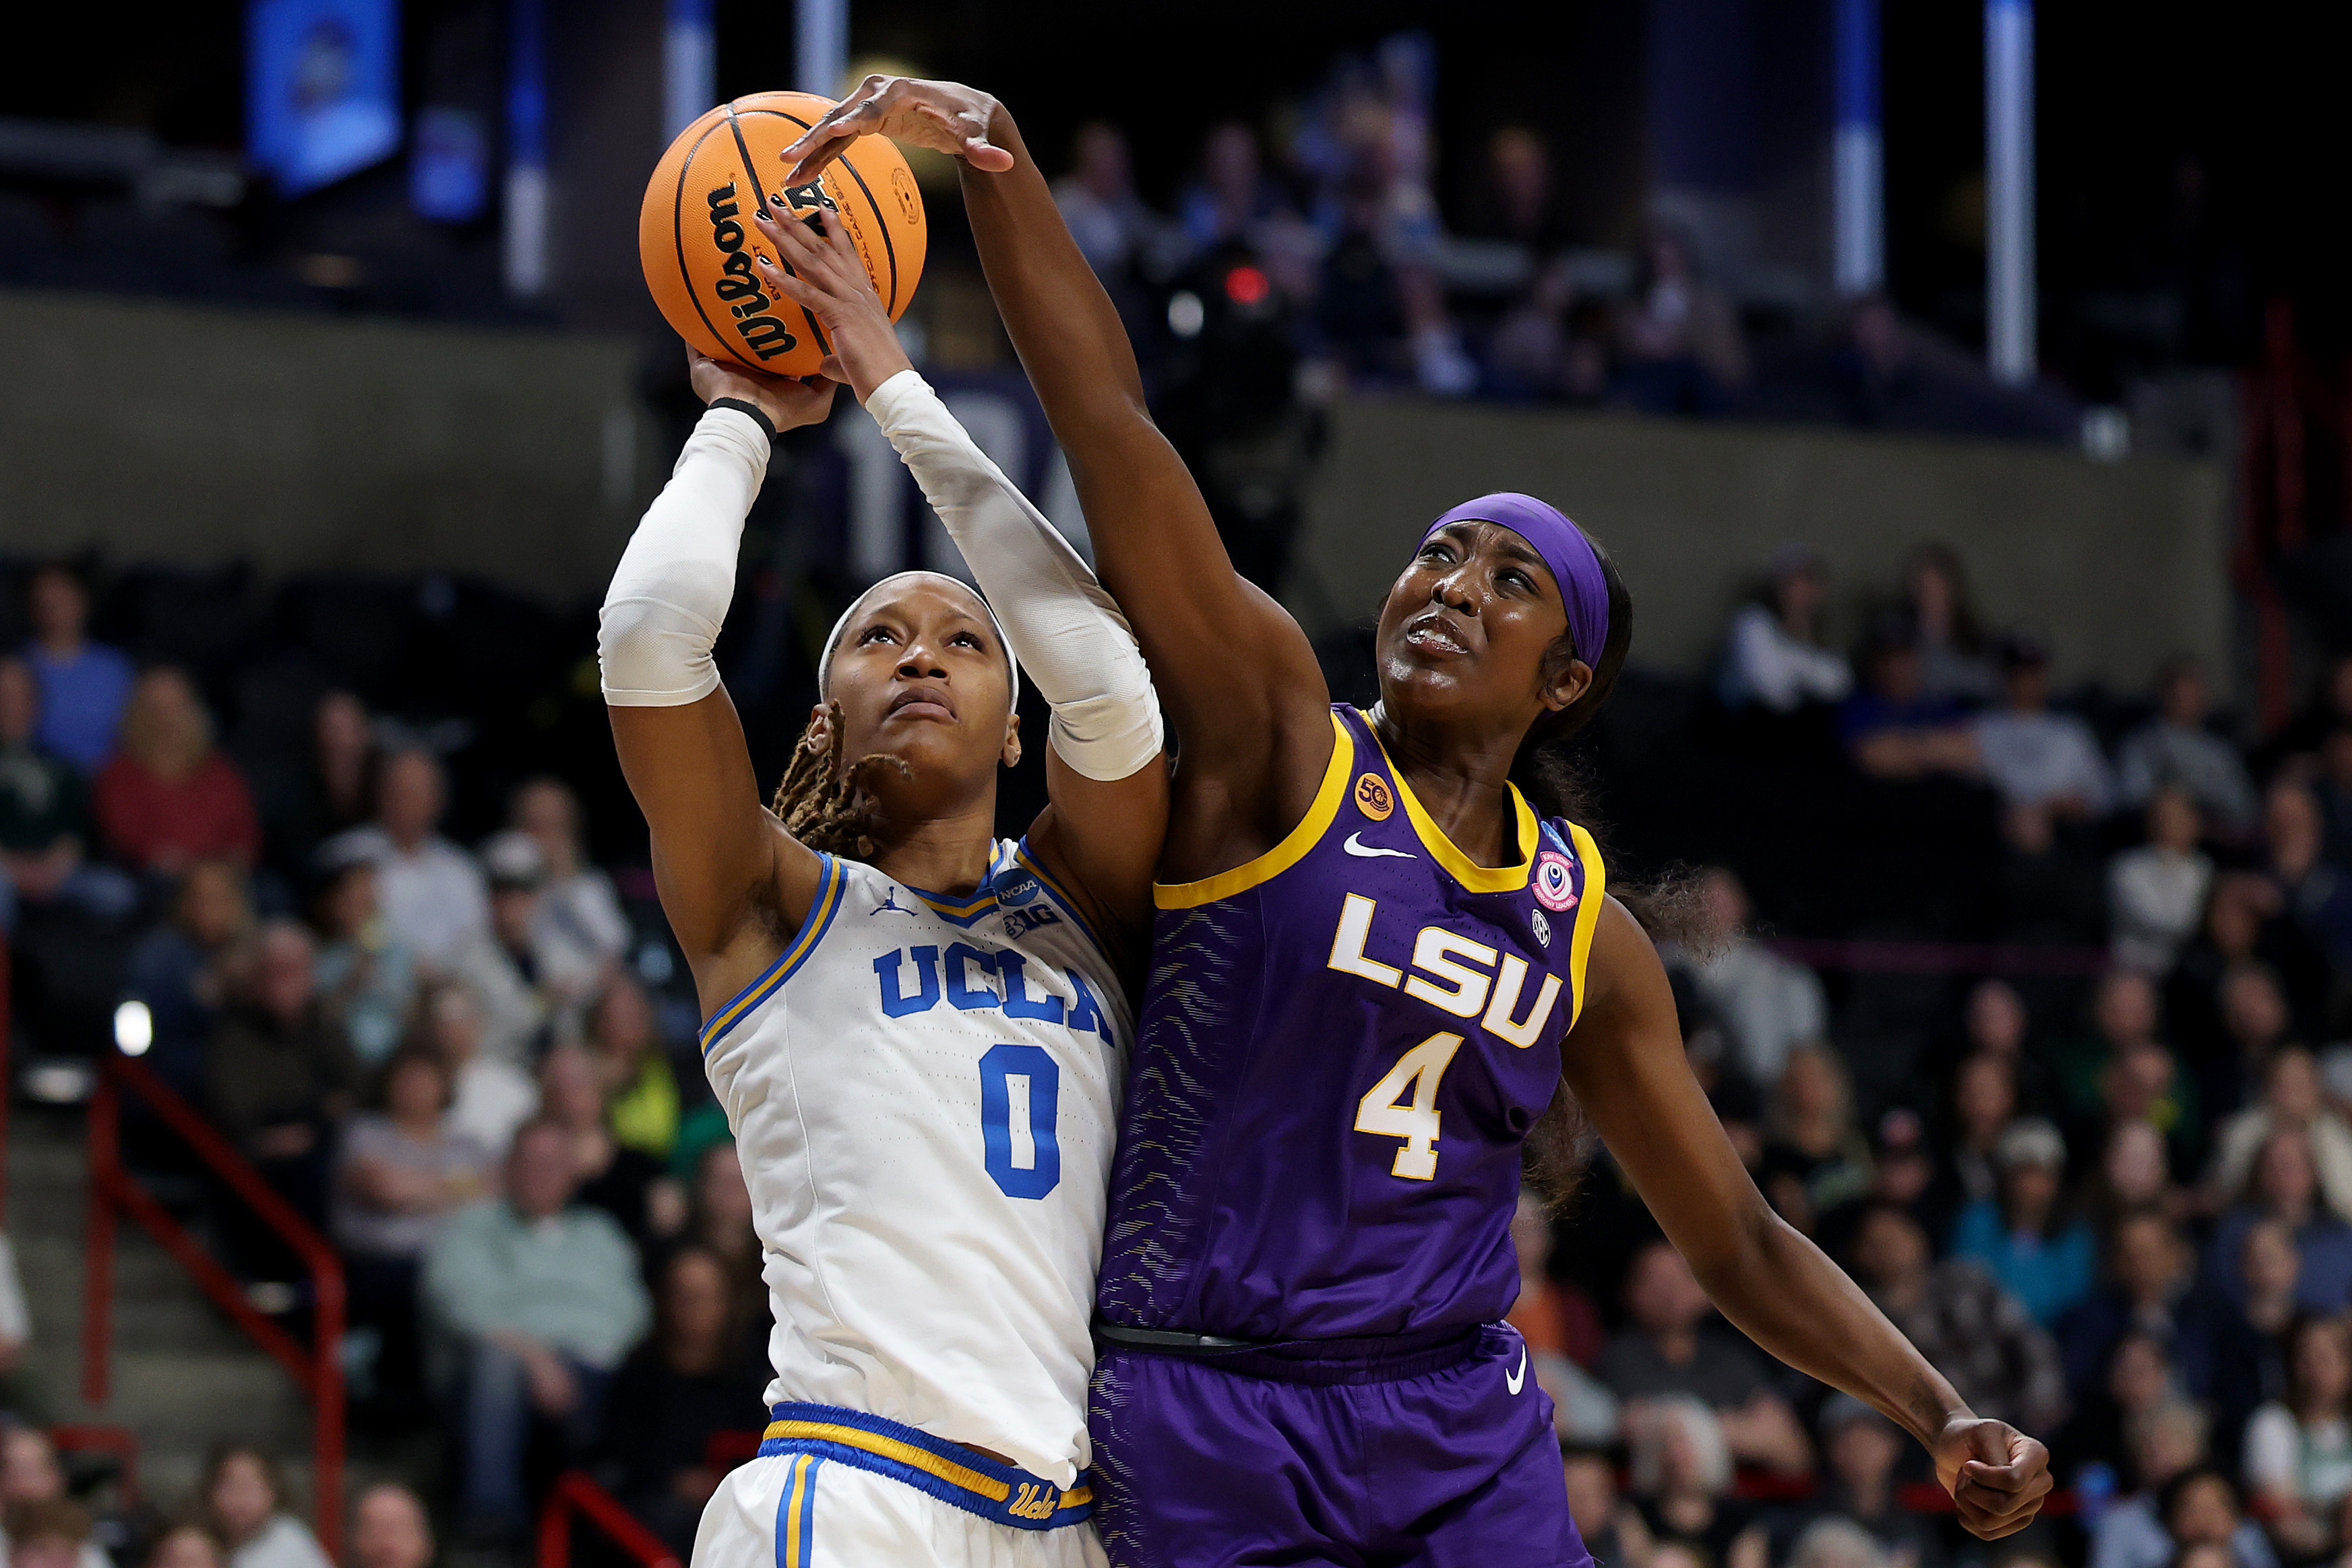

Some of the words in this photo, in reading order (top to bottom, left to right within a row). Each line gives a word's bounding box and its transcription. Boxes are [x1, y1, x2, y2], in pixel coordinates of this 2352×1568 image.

[708, 181, 797, 361] Wilson
[1358, 777, 1388, 805] 50
[999, 880, 1038, 900] NCAA
[1533, 913, 1549, 945] SEC
[873, 941, 1115, 1048] UCLA
[1327, 892, 1564, 1048] LSU
[979, 1044, 1061, 1200] 0
[1353, 1031, 1465, 1181] 4
